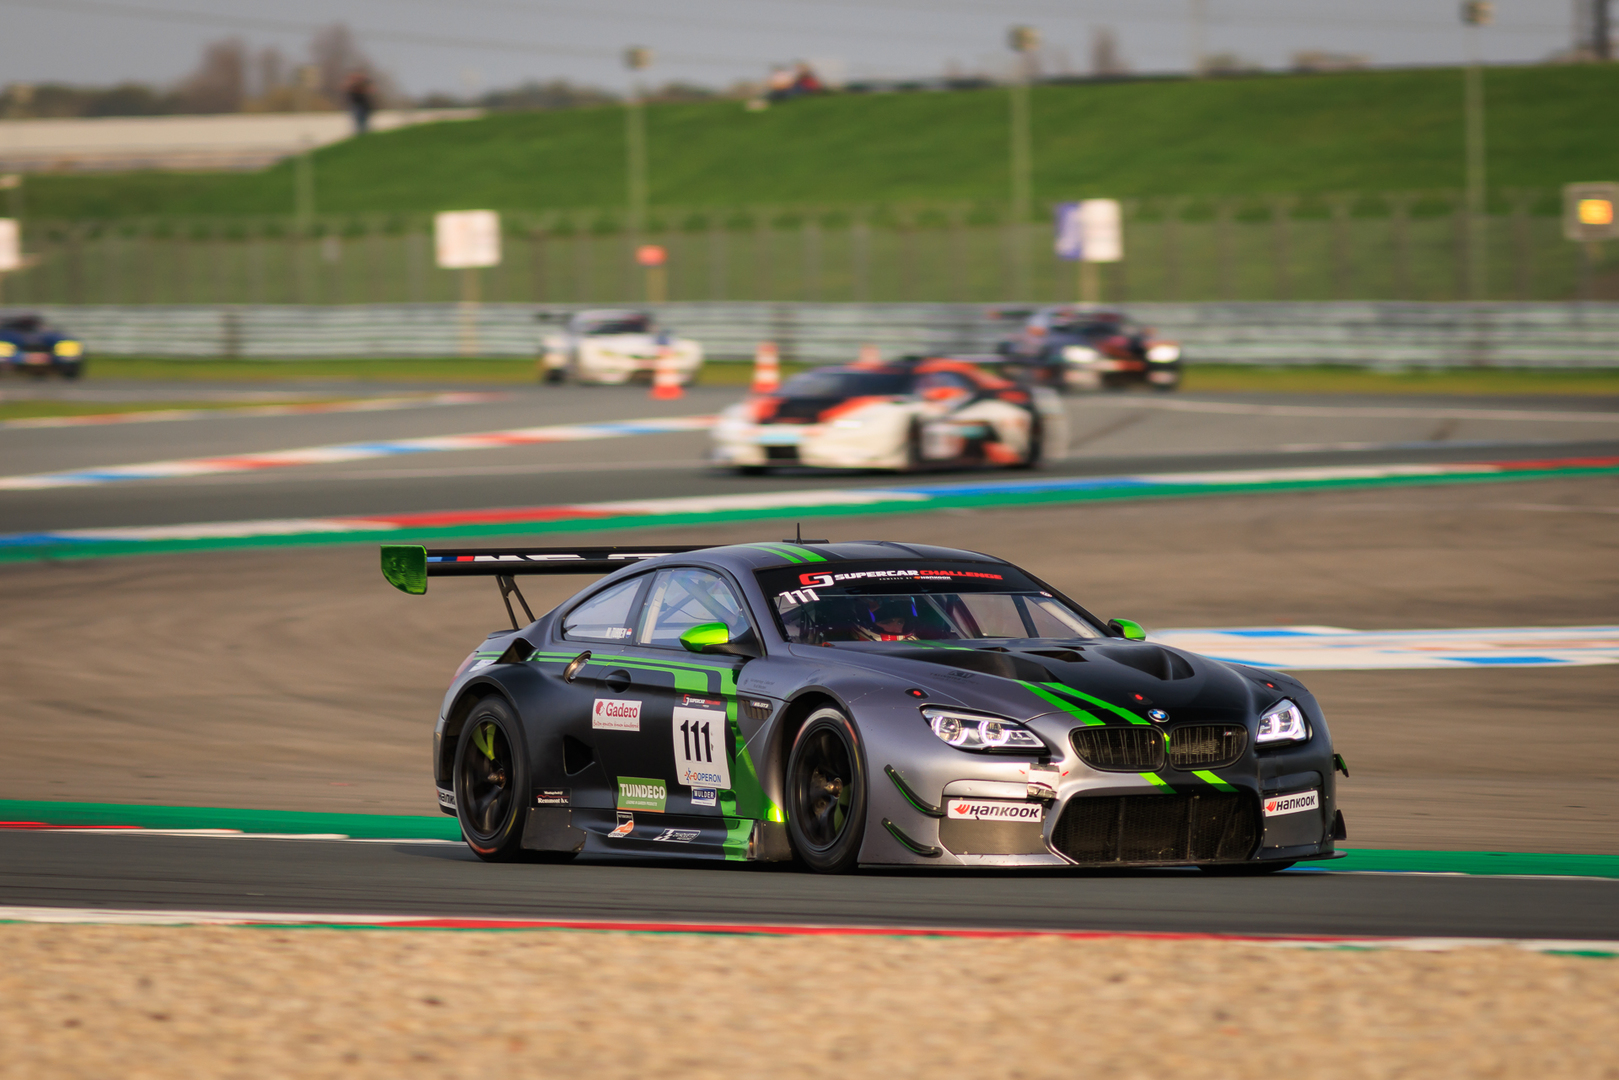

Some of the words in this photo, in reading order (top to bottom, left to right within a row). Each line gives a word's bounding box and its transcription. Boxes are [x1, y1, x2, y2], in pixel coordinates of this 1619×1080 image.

[834, 570, 920, 581] SUPERCAR
[920, 569, 1003, 580] CHALLENGE
[778, 588, 820, 605] 111
[605, 701, 638, 719] Gadero
[680, 719, 713, 763] 111
[619, 783, 666, 800] TUINDECO
